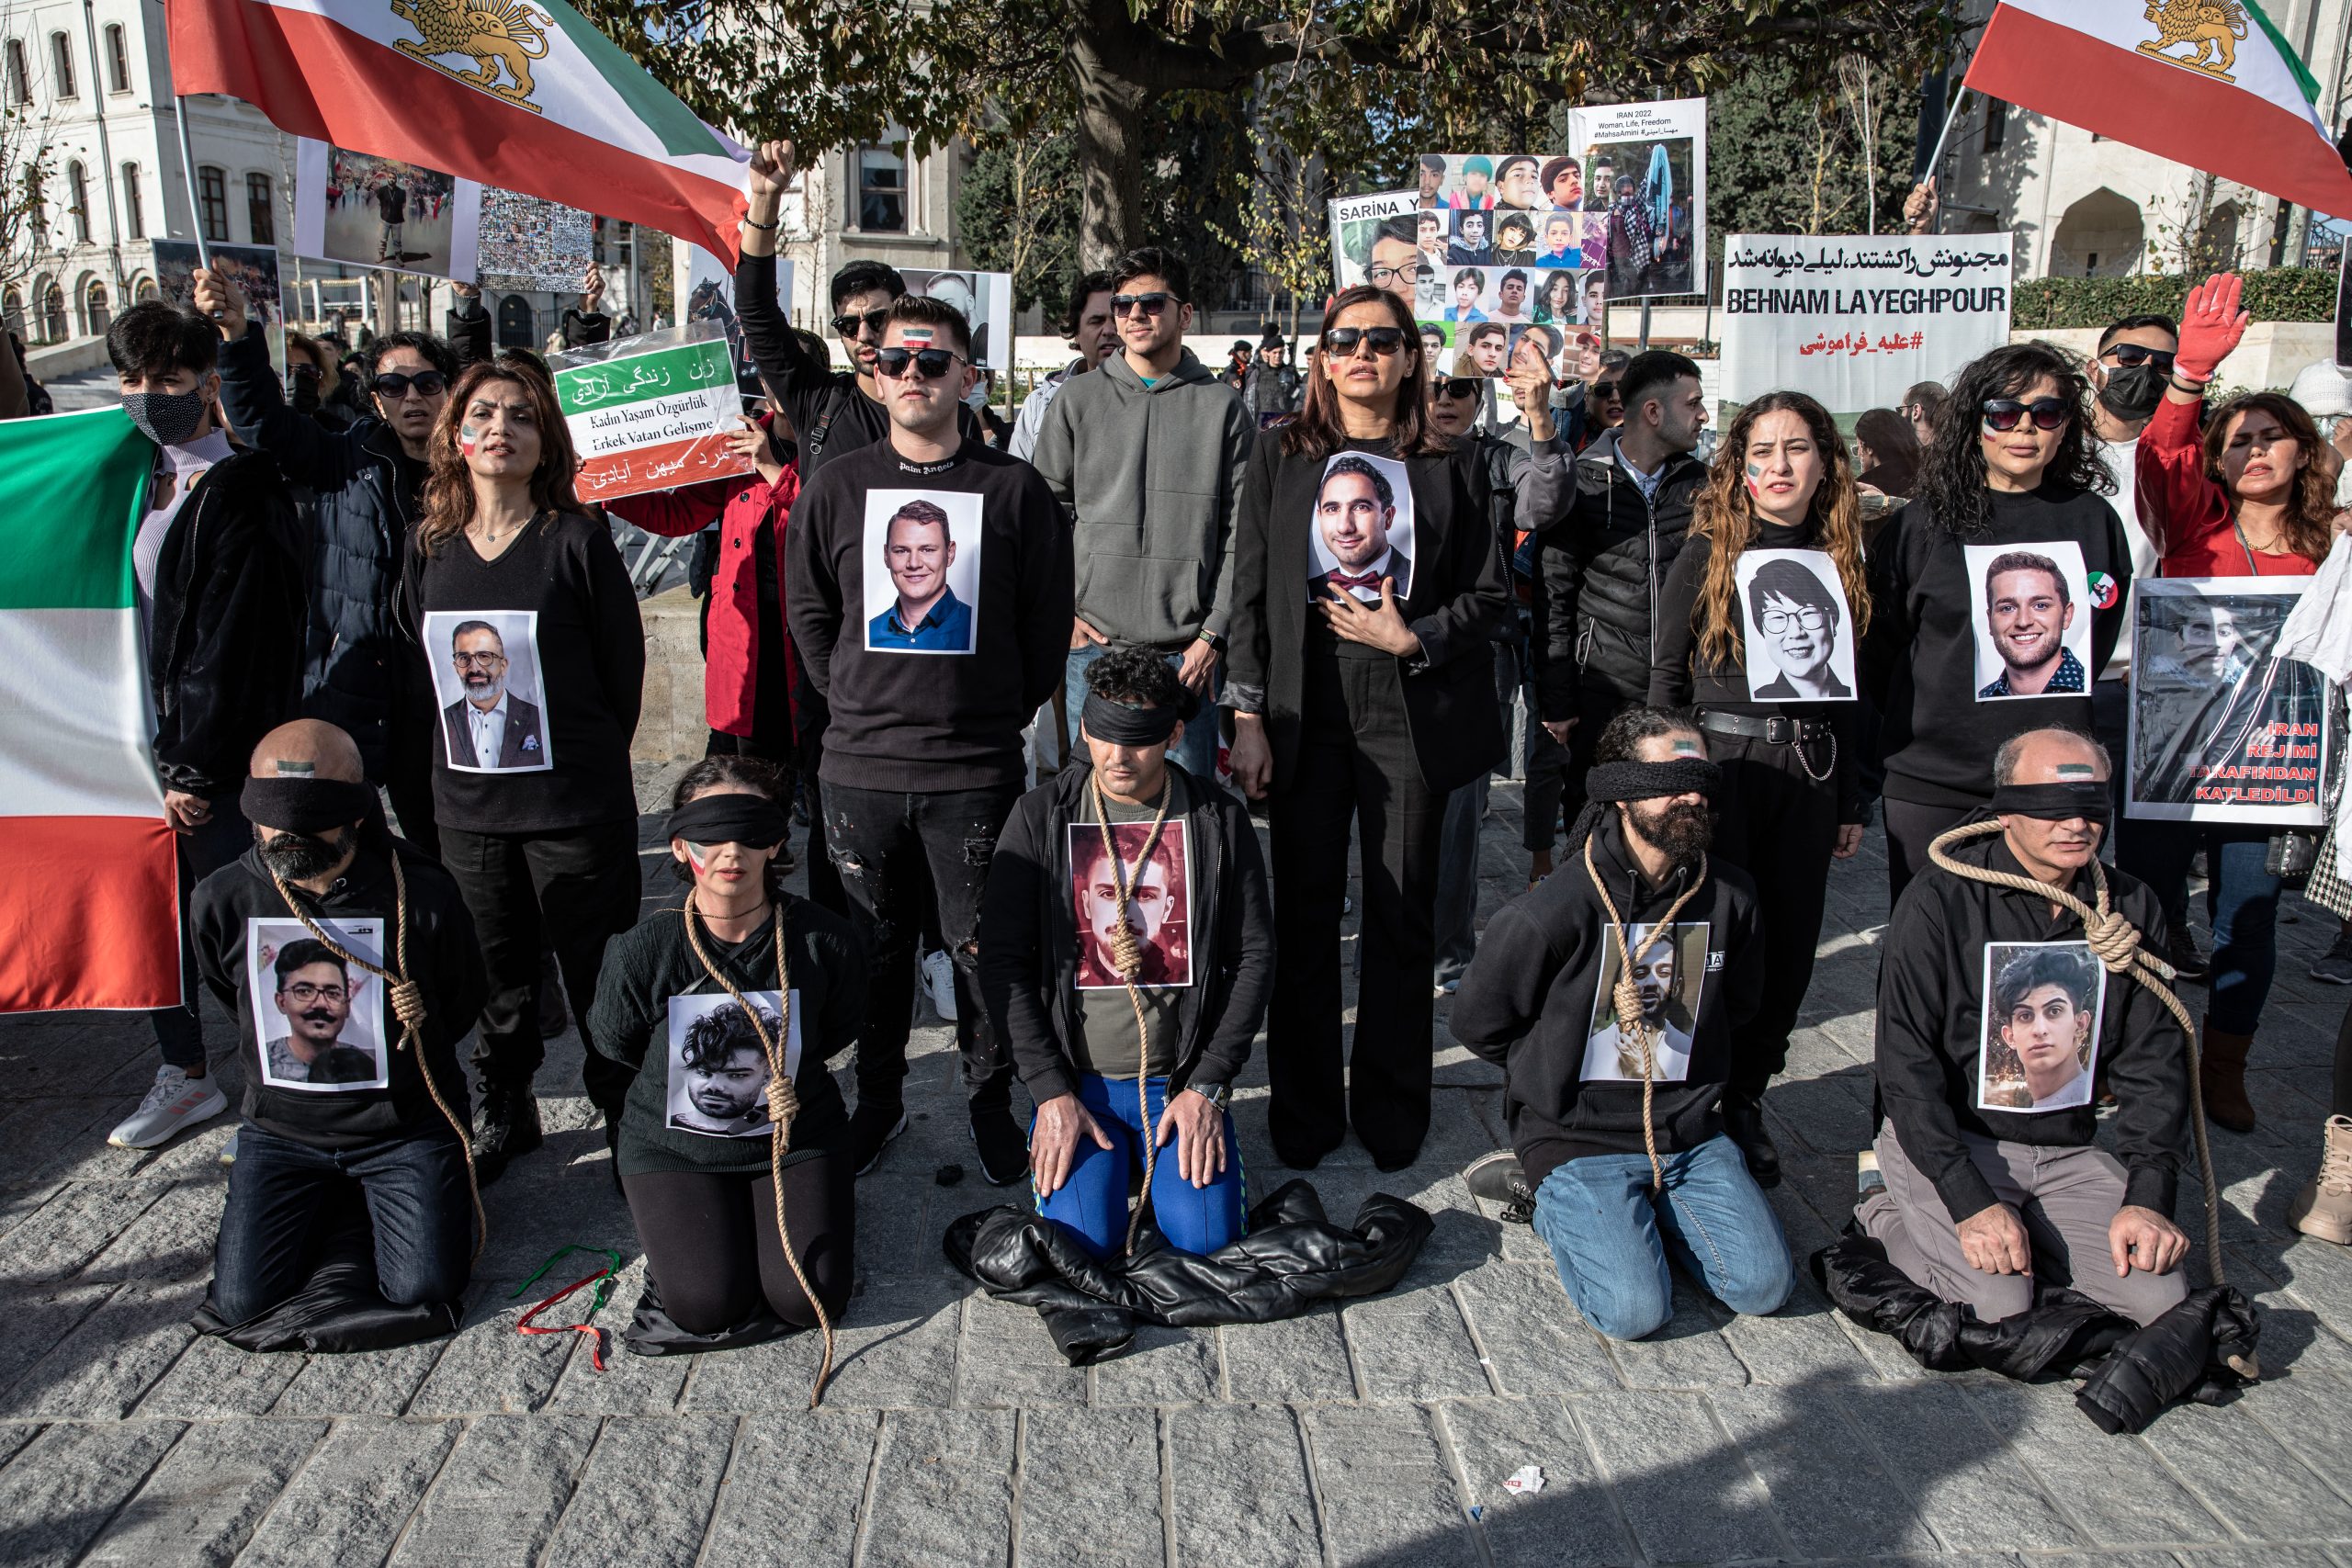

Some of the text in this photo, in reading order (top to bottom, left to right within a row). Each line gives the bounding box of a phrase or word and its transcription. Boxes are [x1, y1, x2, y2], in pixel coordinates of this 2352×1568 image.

[1641, 118, 1671, 127] Freedom
[1594, 130, 1639, 139] #MahsaAmini
[1340, 201, 1399, 220] SARİNA
[1727, 287, 2006, 314] BEHNAM LAYEGHPOUR
[572, 358, 715, 405] زن زندگی آزادی
[590, 394, 707, 429] Kadın Yaşam Özgürlük
[593, 420, 714, 451] Erkek Vatan Gelişme
[593, 459, 632, 491] آبادی
[646, 459, 685, 480] میهن
[2267, 720, 2318, 737] İRAN
[2246, 742, 2317, 759] REJİMİ
[2187, 765, 2316, 781] TARAFINDAN
[2196, 786, 2316, 804] KATLEDİLDİ
